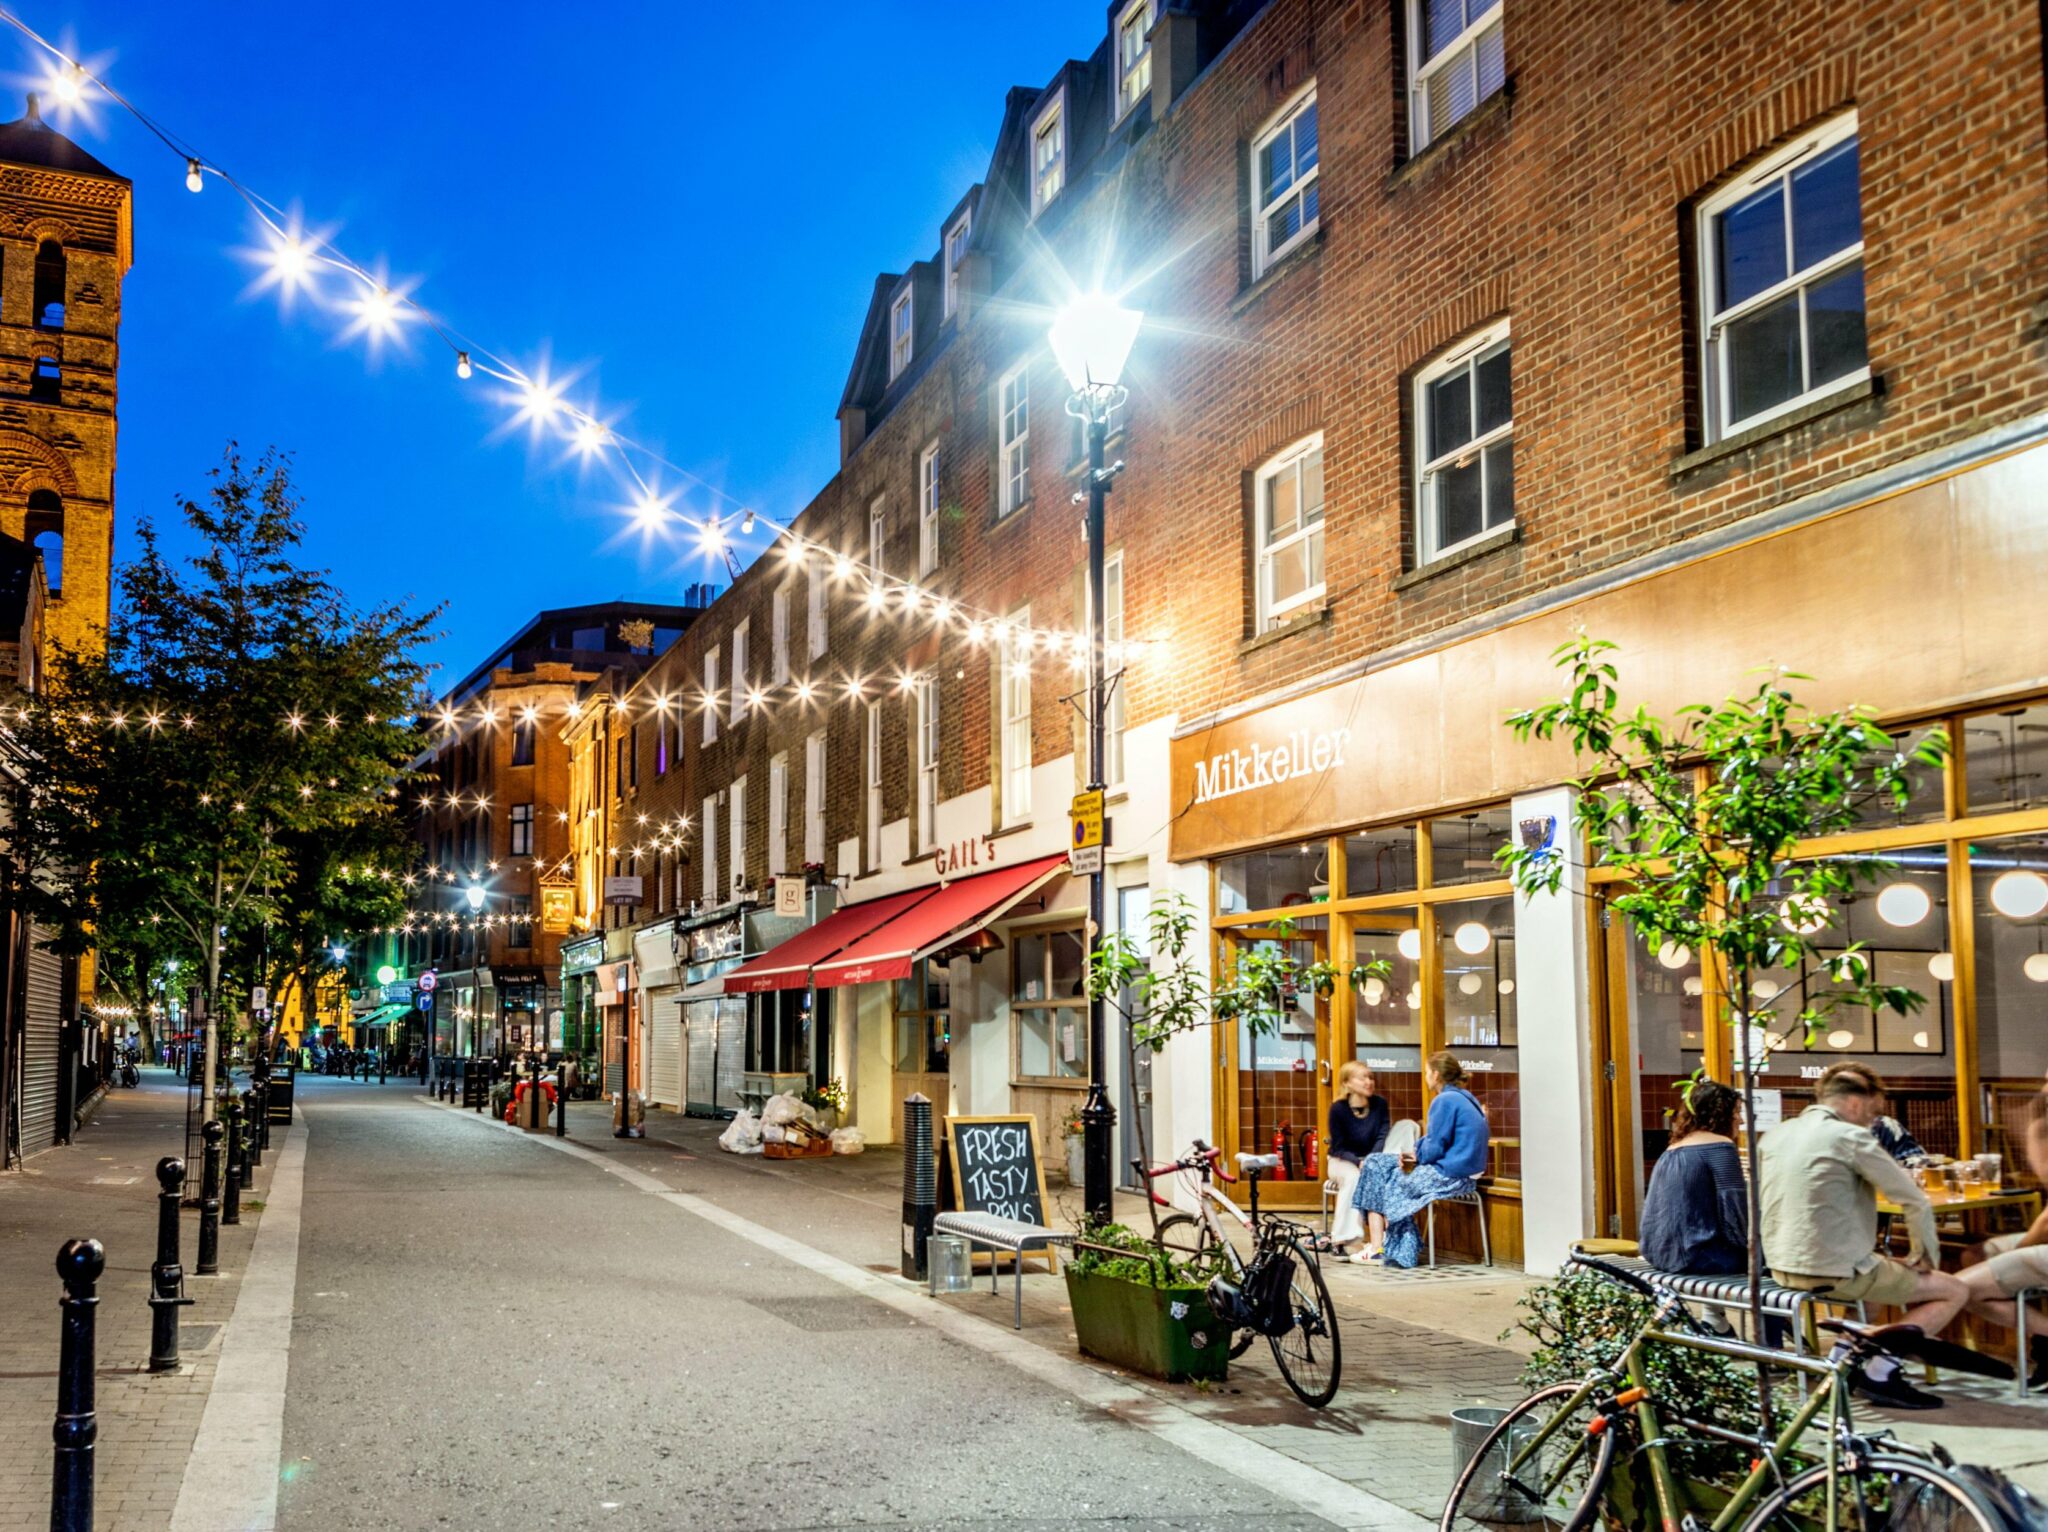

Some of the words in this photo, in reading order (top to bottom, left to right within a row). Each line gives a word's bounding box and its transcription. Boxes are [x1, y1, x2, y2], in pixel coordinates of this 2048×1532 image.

[1195, 727, 1350, 804] Mikkeller
[784, 889, 796, 905] g
[962, 1127, 1027, 1166] FRESH
[968, 1165, 1029, 1202] TASTY
